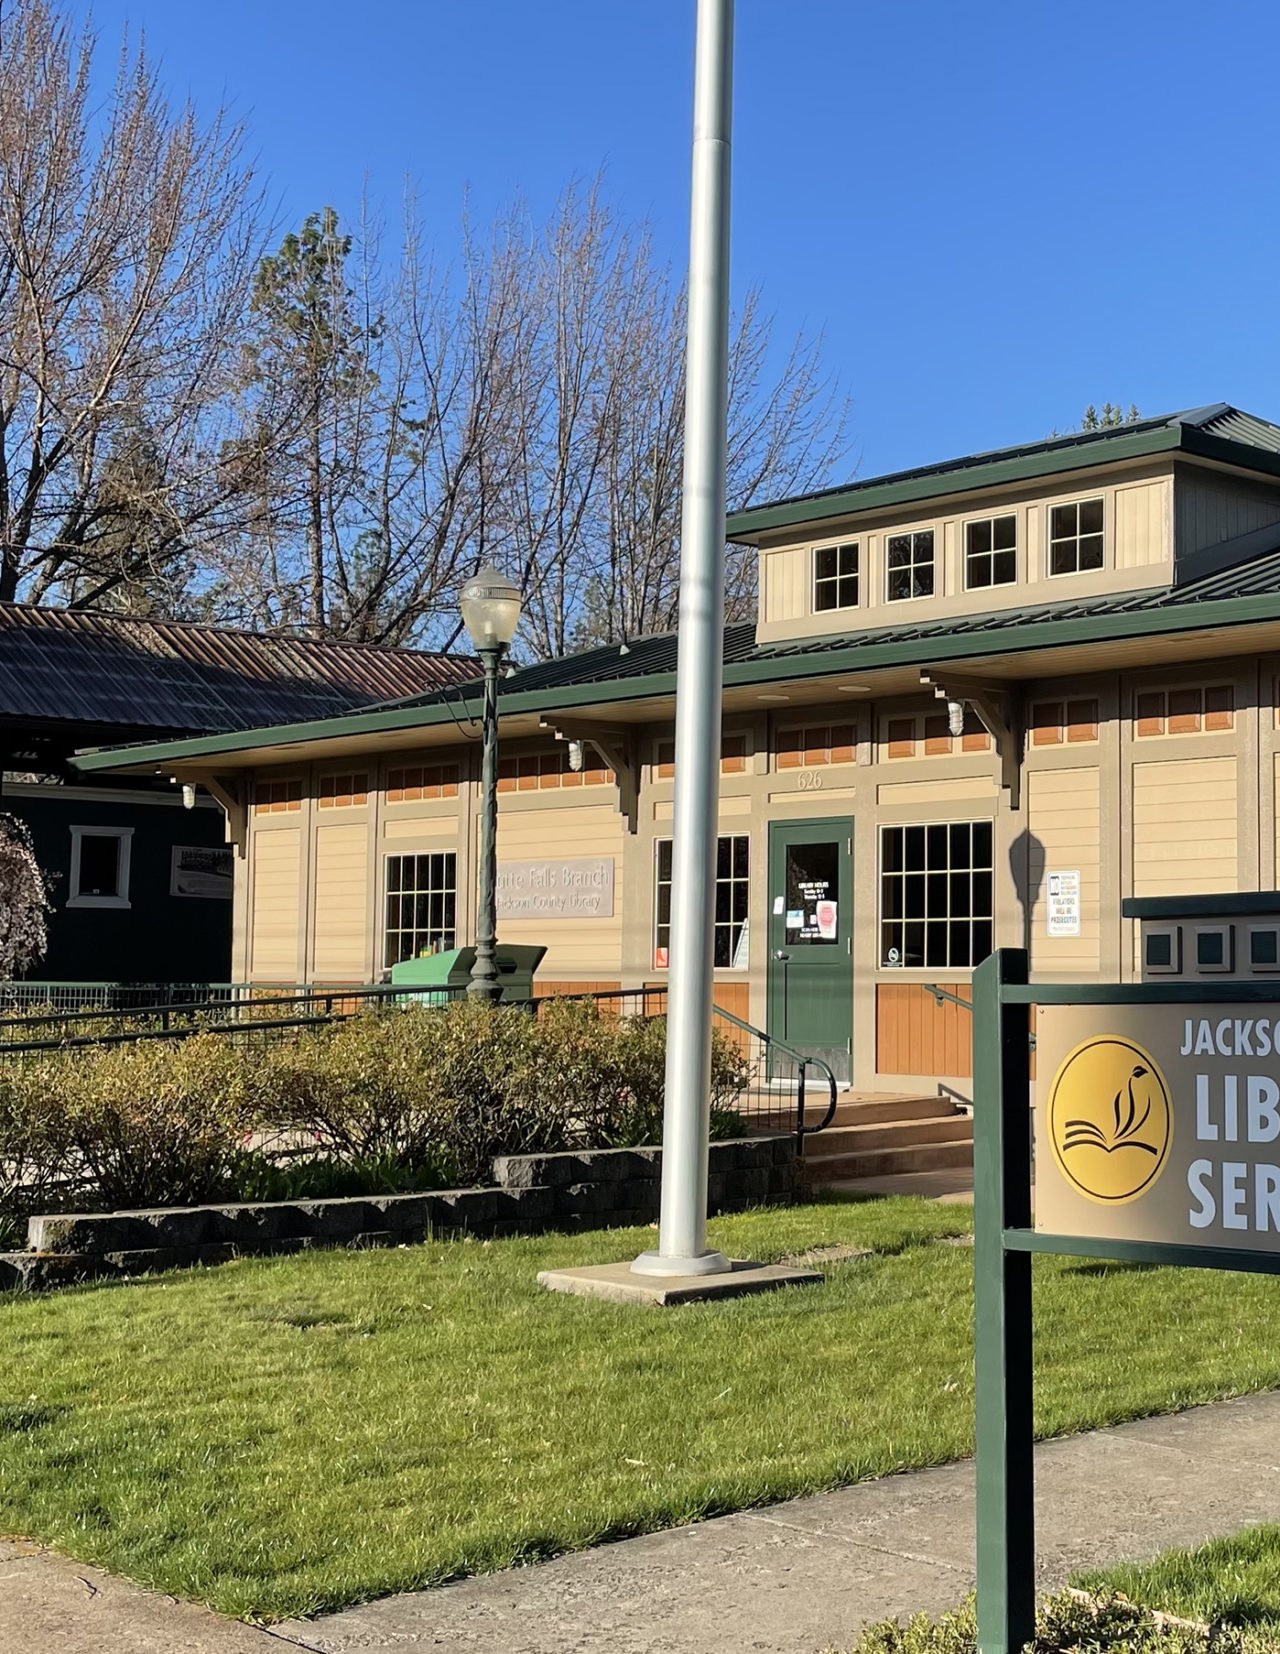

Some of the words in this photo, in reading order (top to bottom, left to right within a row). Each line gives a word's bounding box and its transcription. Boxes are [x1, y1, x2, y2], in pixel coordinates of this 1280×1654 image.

[798, 770, 823, 790] 626
[496, 872, 525, 889] utte
[530, 865, 557, 889] Falls
[562, 862, 610, 888] Branch
[533, 894, 567, 912] County
[569, 890, 601, 913] Library
